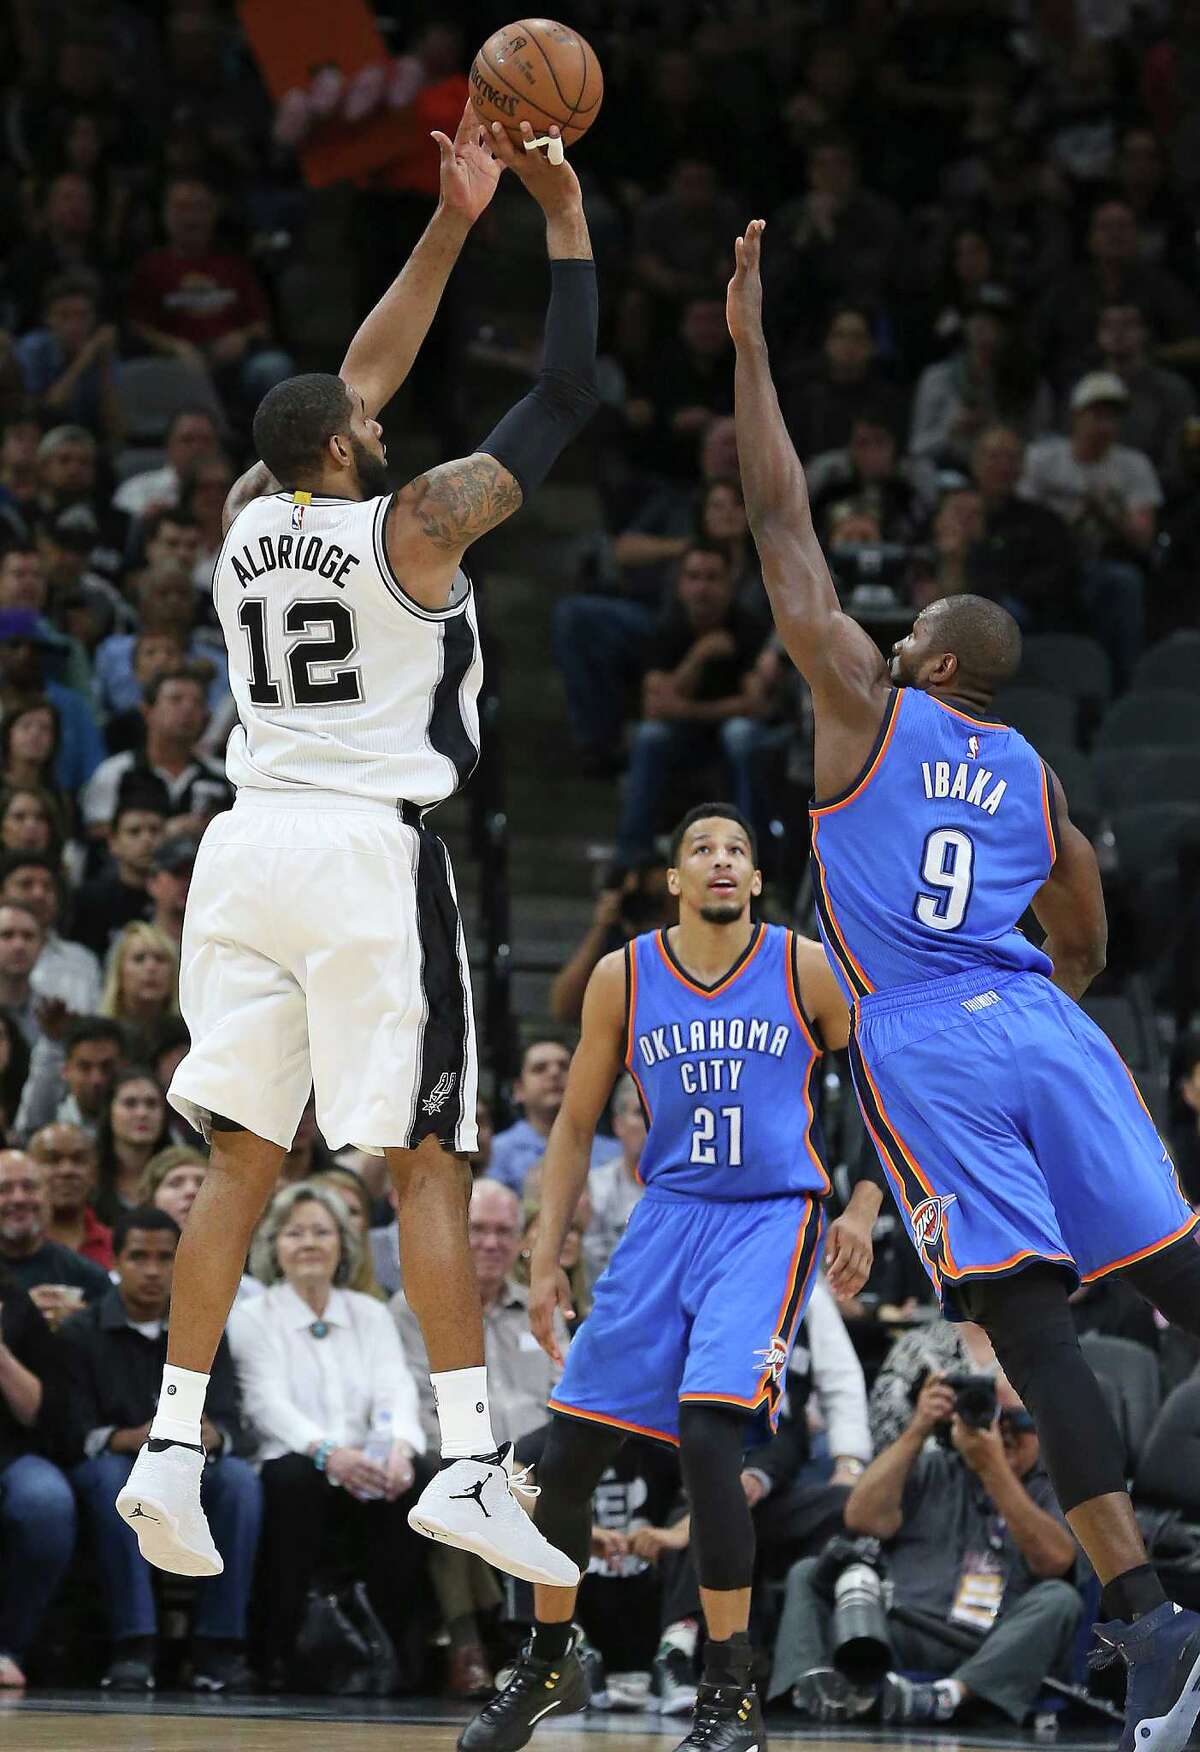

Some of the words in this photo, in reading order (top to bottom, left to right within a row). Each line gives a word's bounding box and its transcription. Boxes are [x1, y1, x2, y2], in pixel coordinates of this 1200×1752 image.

[470, 62, 519, 116] SPALDI
[231, 535, 360, 589] ALDRIDGE
[238, 597, 363, 708] 12
[921, 761, 1008, 816] IBAKA
[914, 826, 975, 932] 9
[960, 990, 1002, 1013] THUNDER
[638, 1018, 790, 1067] OKLAHOMA
[680, 1058, 743, 1095] CITY
[689, 1105, 742, 1167] 21
